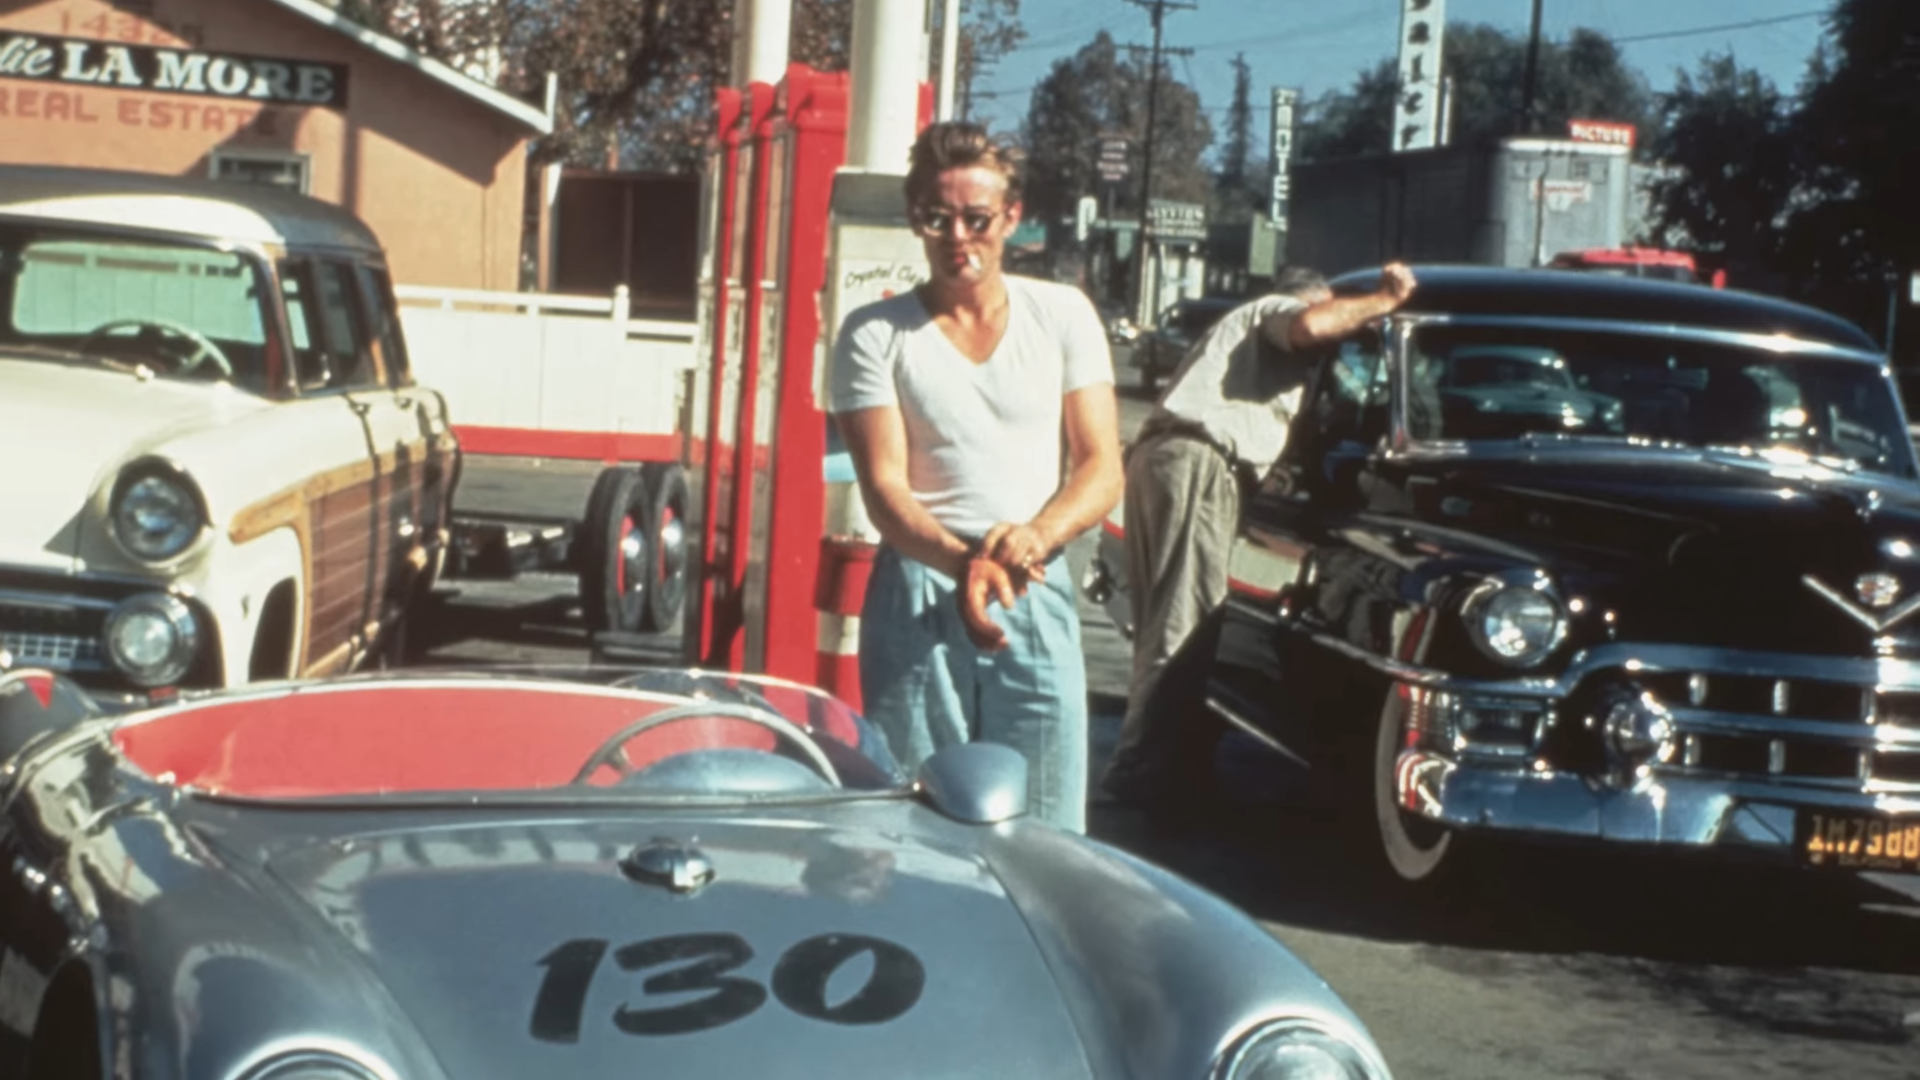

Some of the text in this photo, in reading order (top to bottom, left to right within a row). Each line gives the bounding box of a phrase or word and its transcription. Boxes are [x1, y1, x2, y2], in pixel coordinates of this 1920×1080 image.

[60, 43, 142, 86] LA
[153, 52, 335, 102] MORE
[117, 98, 277, 136] ESTATE
[1272, 105, 1293, 224] MOTEL
[529, 932, 926, 1044] 130
